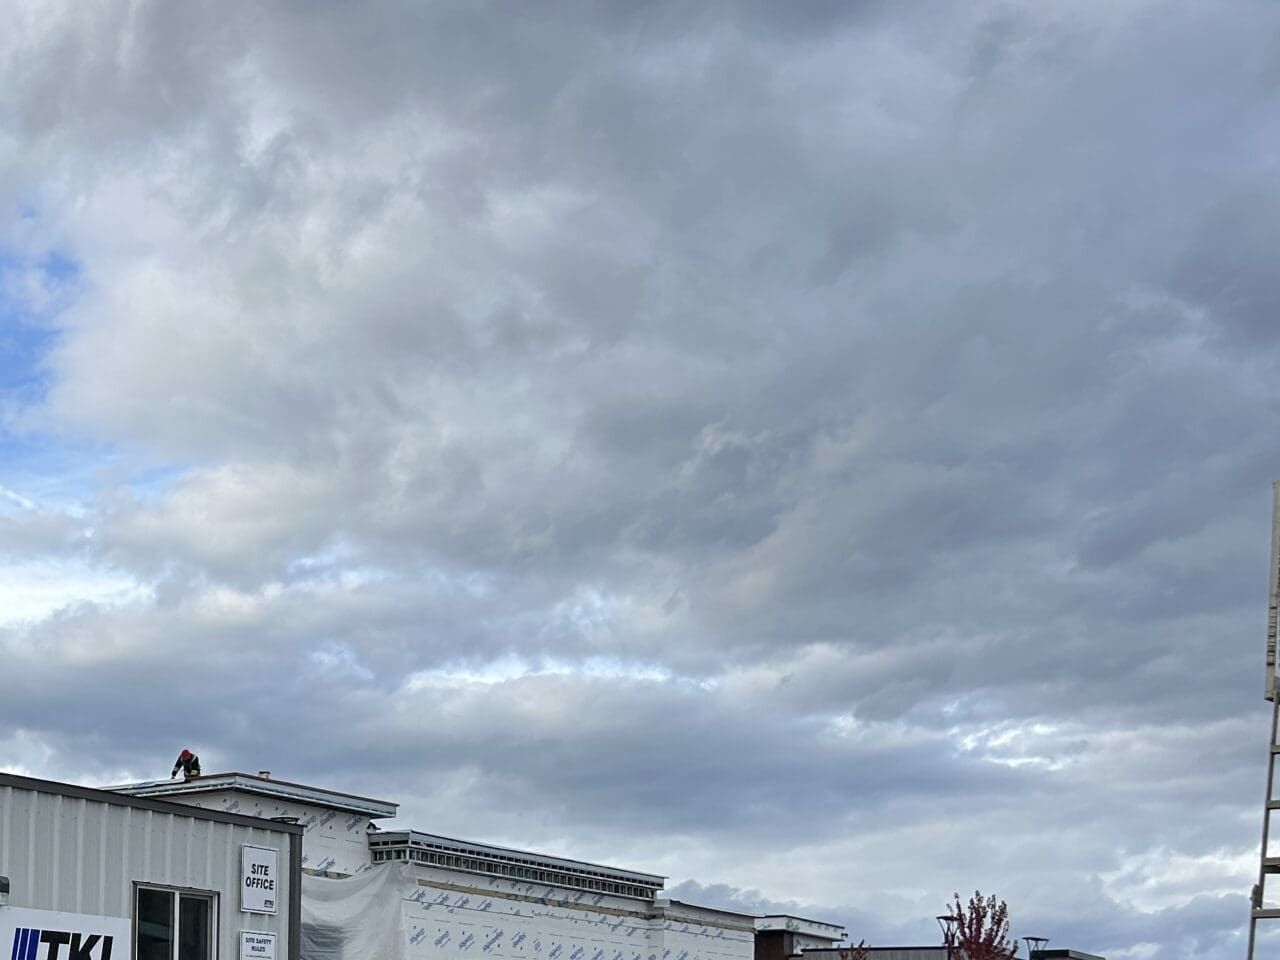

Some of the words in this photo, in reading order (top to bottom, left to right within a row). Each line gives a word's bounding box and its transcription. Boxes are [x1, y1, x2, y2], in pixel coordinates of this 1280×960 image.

[251, 863, 269, 876] SITE
[245, 877, 274, 890] OFFICE
[256, 937, 272, 945] SAFETY
[251, 945, 266, 953] RULES
